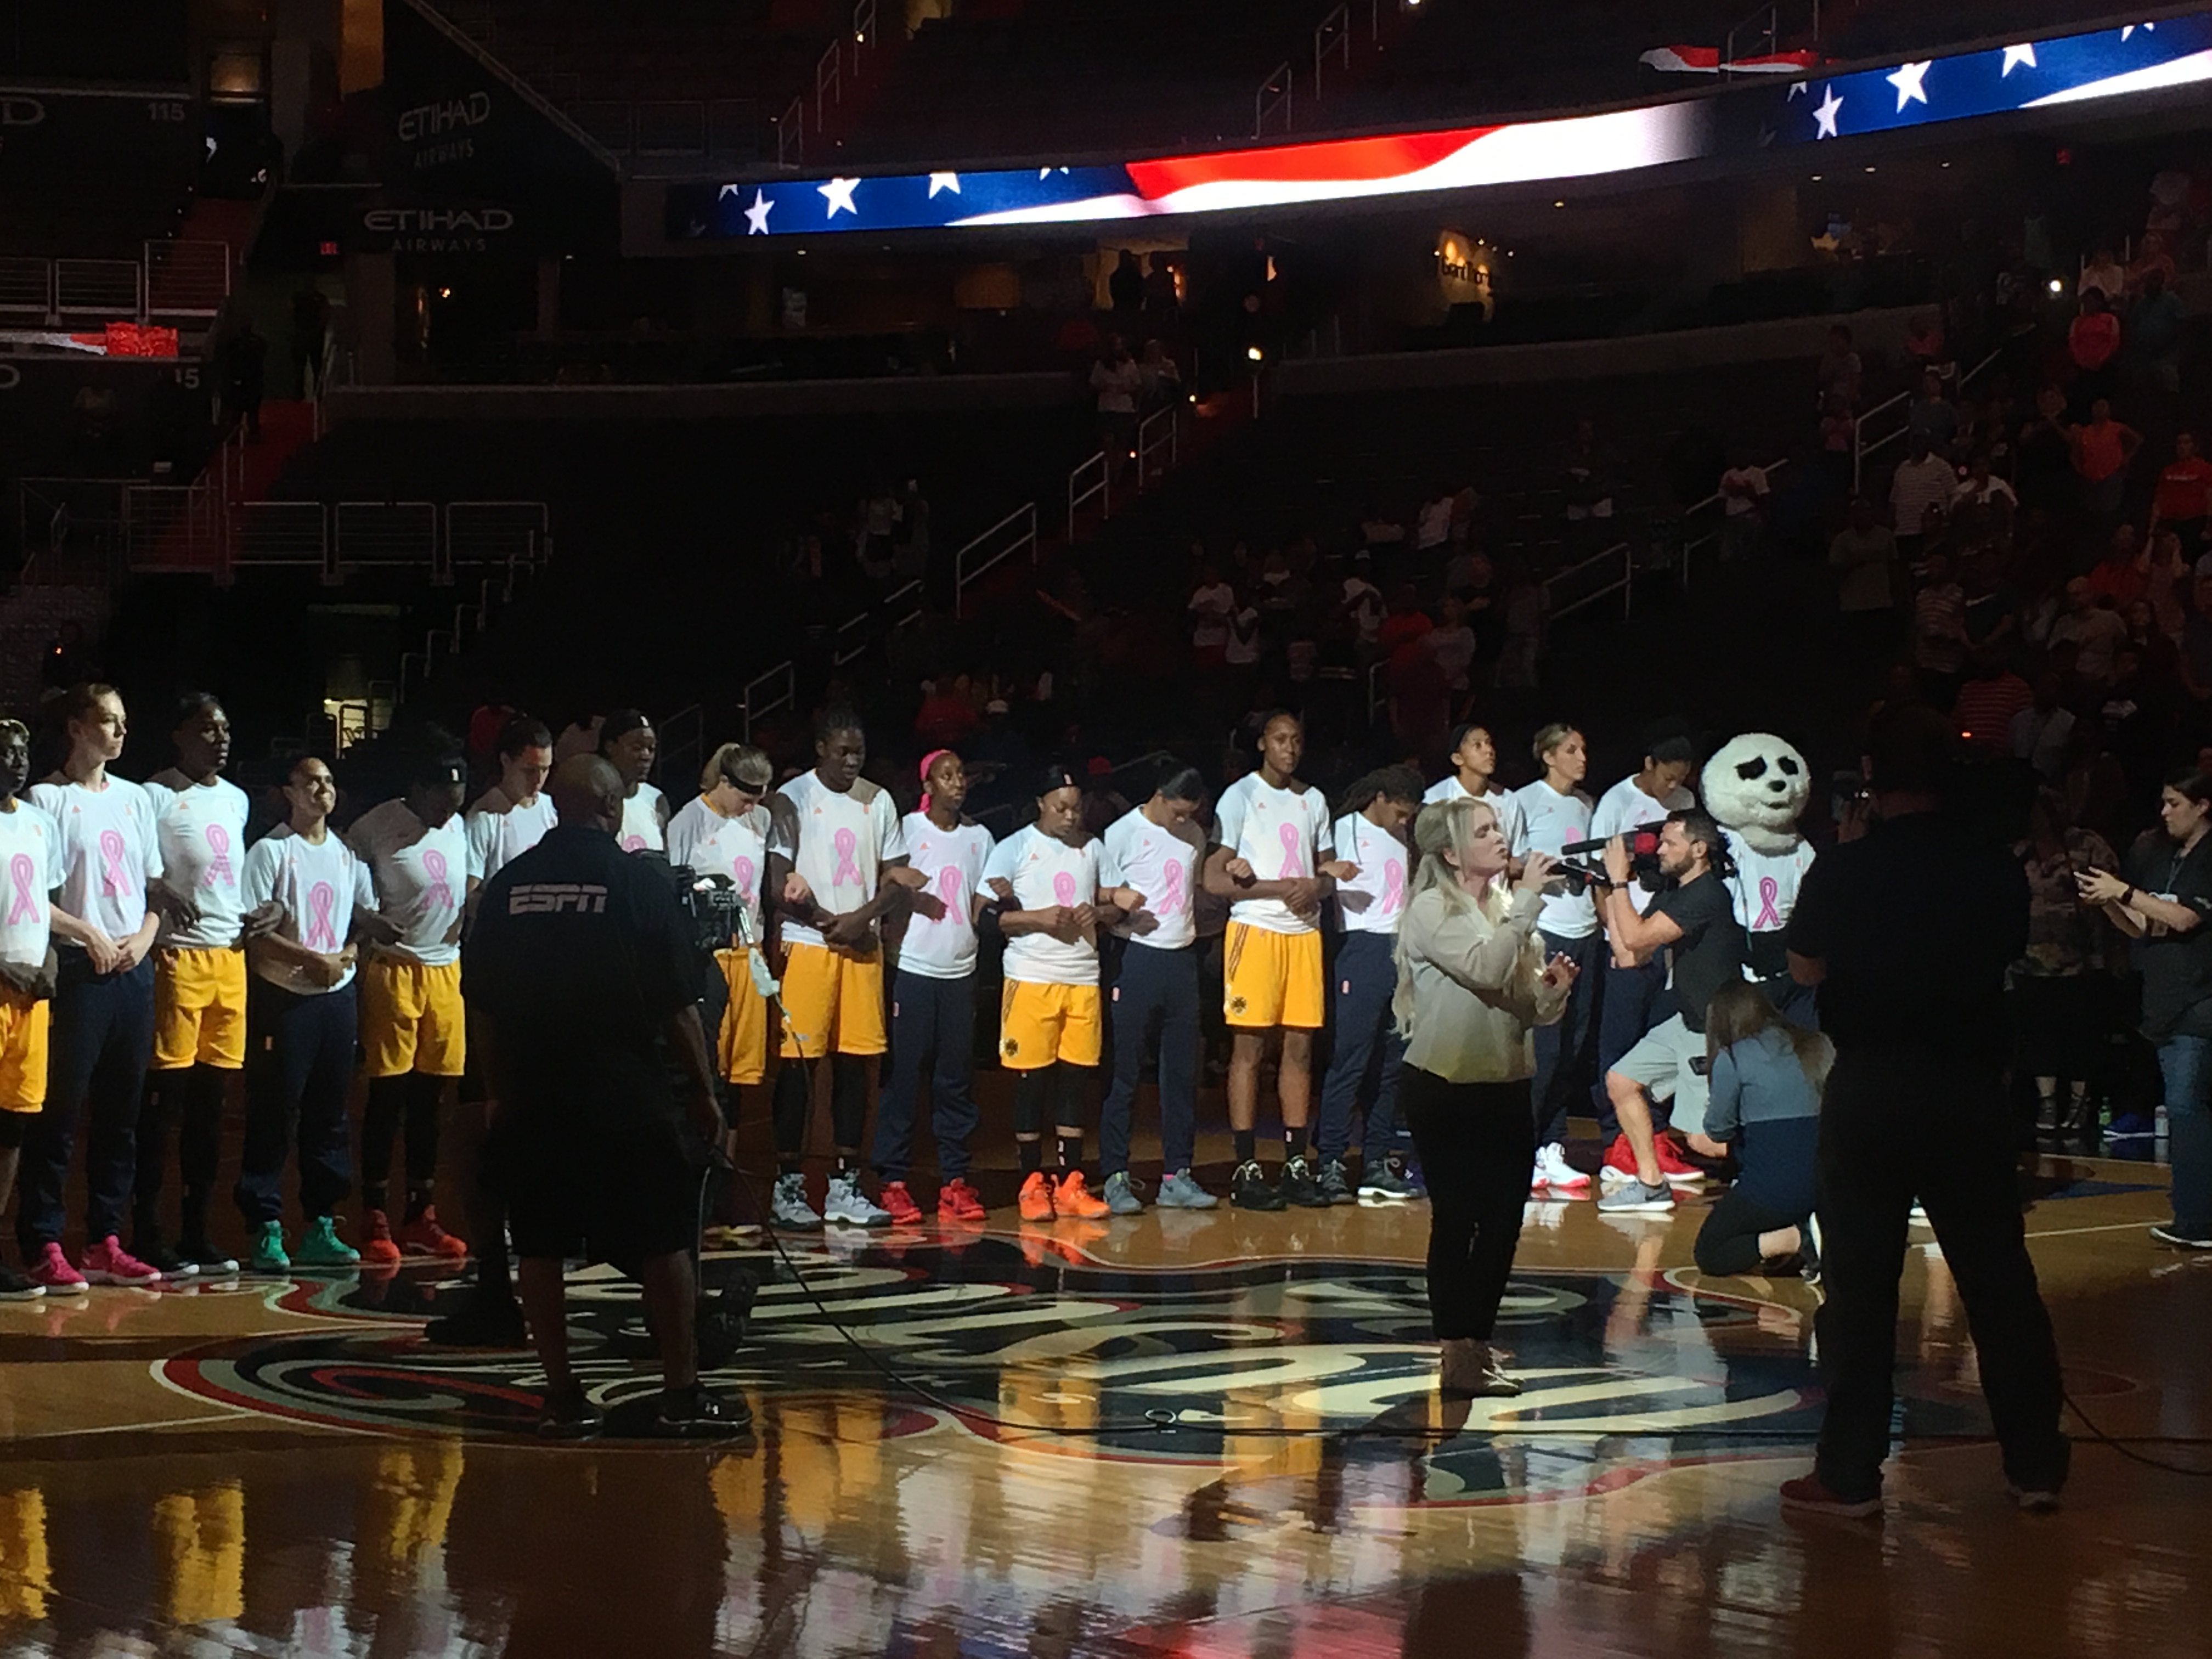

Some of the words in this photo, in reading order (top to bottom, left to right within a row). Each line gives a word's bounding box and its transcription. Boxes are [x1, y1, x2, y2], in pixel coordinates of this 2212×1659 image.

[148, 102, 185, 121] 115
[399, 92, 490, 141] ETIHAD
[415, 139, 473, 168] AIRWAYS
[364, 210, 513, 230] ETIHAD
[392, 238, 486, 252] AIRWAYS
[509, 883, 608, 916] ESPN
